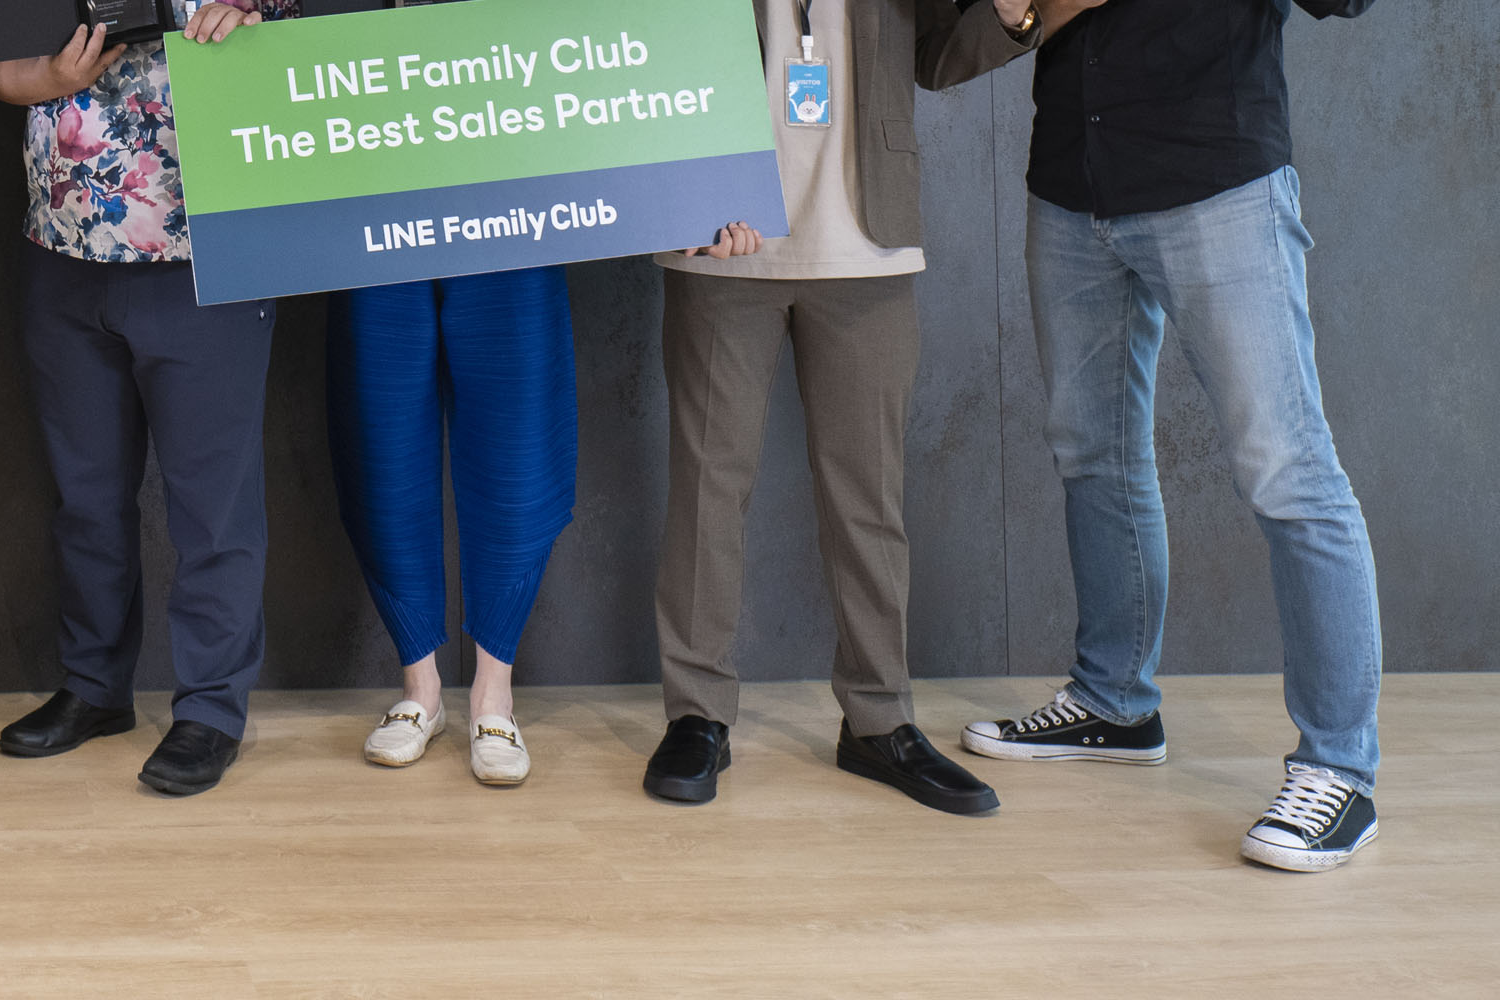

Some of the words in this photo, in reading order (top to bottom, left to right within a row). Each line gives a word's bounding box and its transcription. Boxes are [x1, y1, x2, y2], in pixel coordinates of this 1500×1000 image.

[286, 57, 389, 103] LINE
[397, 43, 538, 91] Family
[549, 31, 649, 74] Club
[230, 124, 316, 163] The
[325, 112, 425, 154] Best
[433, 96, 546, 142] Sales
[555, 83, 716, 129] Partner
[364, 219, 436, 252] LINE
[443, 207, 546, 243] Family
[550, 198, 618, 231] Club
